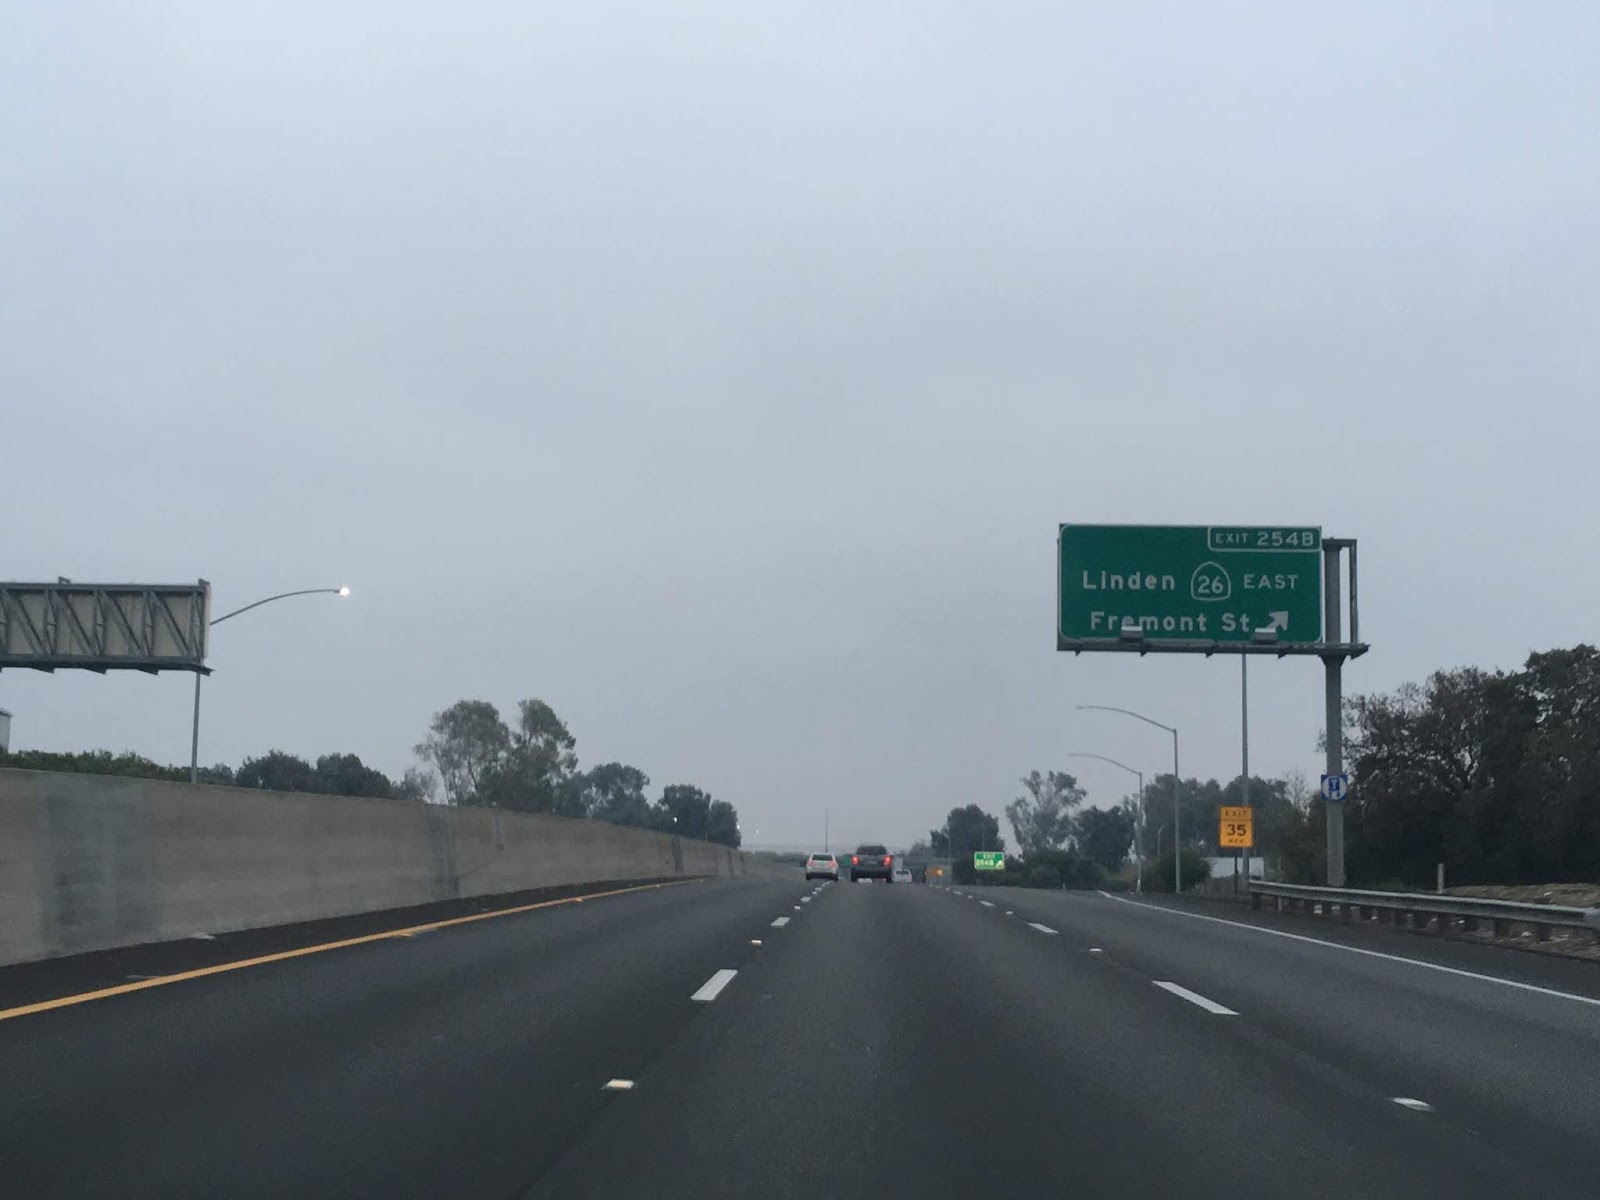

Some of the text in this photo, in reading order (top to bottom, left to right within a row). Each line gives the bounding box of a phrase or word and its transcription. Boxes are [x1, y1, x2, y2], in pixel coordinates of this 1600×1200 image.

[1215, 531, 1314, 546] EXIT 254B
[1082, 570, 1299, 594] Linden 26 EAST
[1090, 611, 1250, 632] Fremont St
[1227, 823, 1247, 837] 35
